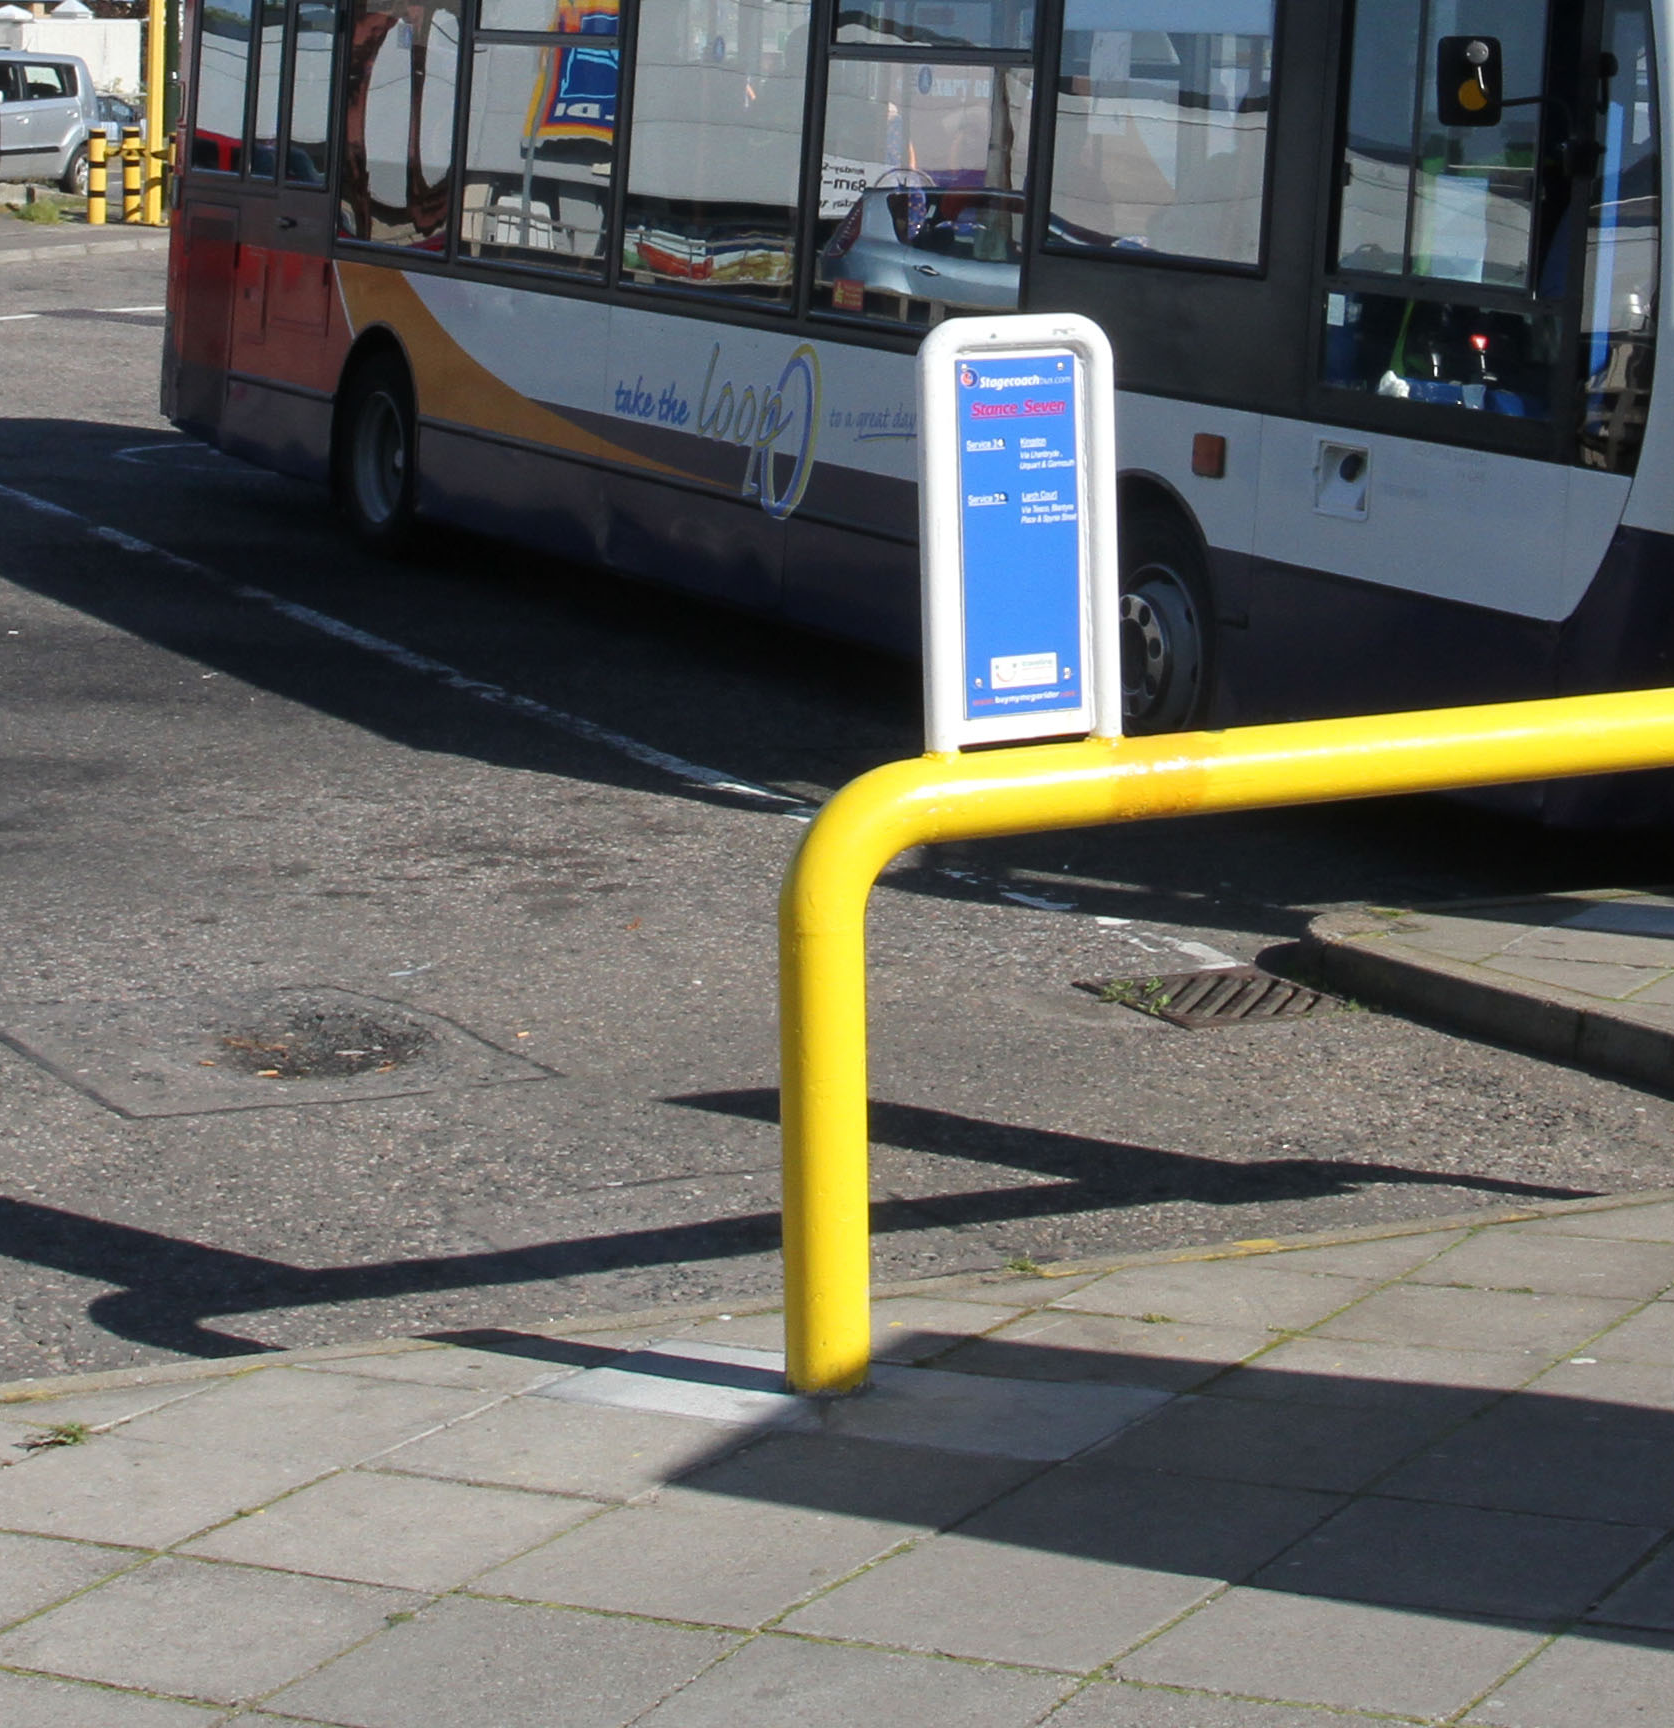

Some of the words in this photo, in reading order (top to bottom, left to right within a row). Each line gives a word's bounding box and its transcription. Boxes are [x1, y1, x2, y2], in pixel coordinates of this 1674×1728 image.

[615, 375, 655, 418] take
[658, 381, 690, 426] the
[971, 402, 1018, 416] Stance
[1023, 399, 1066, 414] Seven
[696, 341, 821, 520] loop
[967, 440, 992, 451] Service
[968, 494, 993, 506] Service
